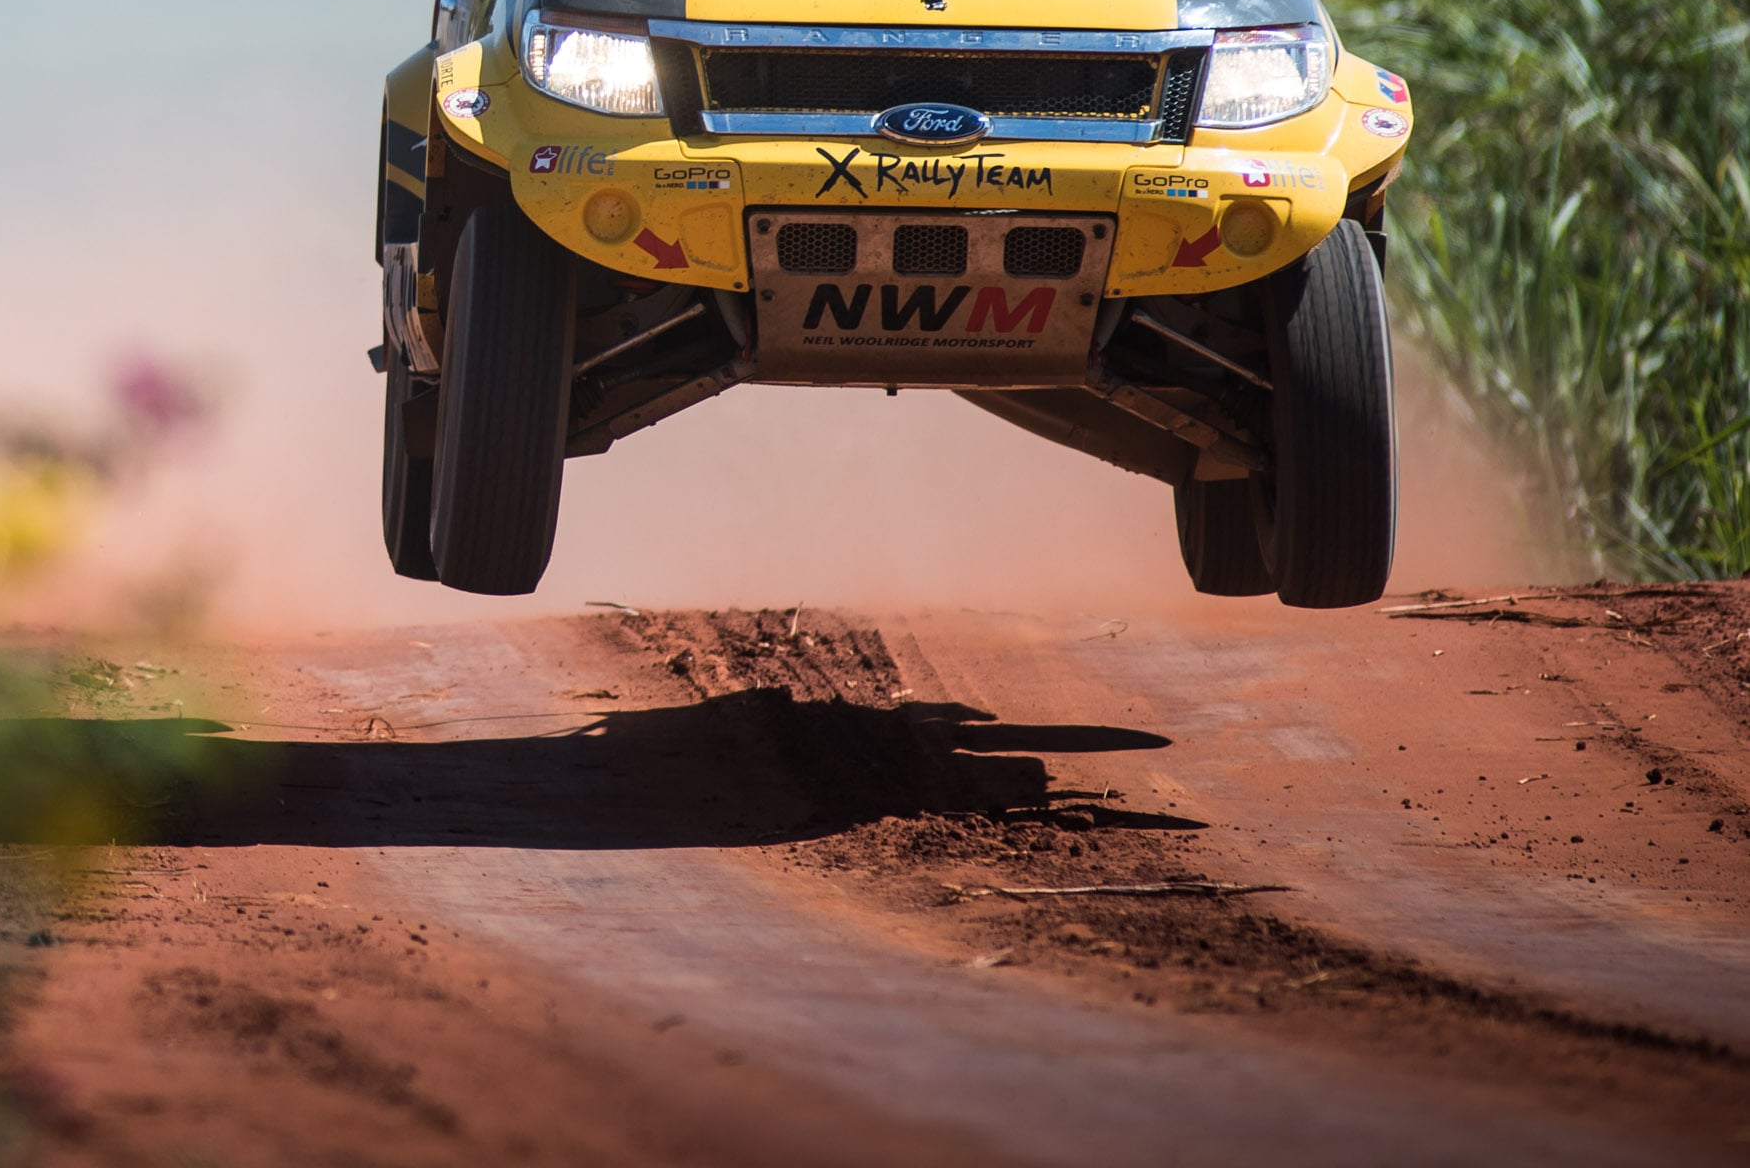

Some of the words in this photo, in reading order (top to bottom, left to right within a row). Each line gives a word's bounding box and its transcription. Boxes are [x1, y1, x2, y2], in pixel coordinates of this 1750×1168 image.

[724, 27, 1142, 49] RANGER
[903, 108, 963, 133] Ford
[557, 145, 607, 175] life
[654, 167, 731, 180] GoPro
[815, 147, 869, 199] X
[1134, 174, 1209, 188] GoPro
[1267, 159, 1315, 188] life
[802, 283, 1057, 332] NWM
[803, 336, 835, 345] NEIL
[839, 336, 931, 347] WOOLRIDGE
[933, 338, 1035, 349] MOTORSPORT
